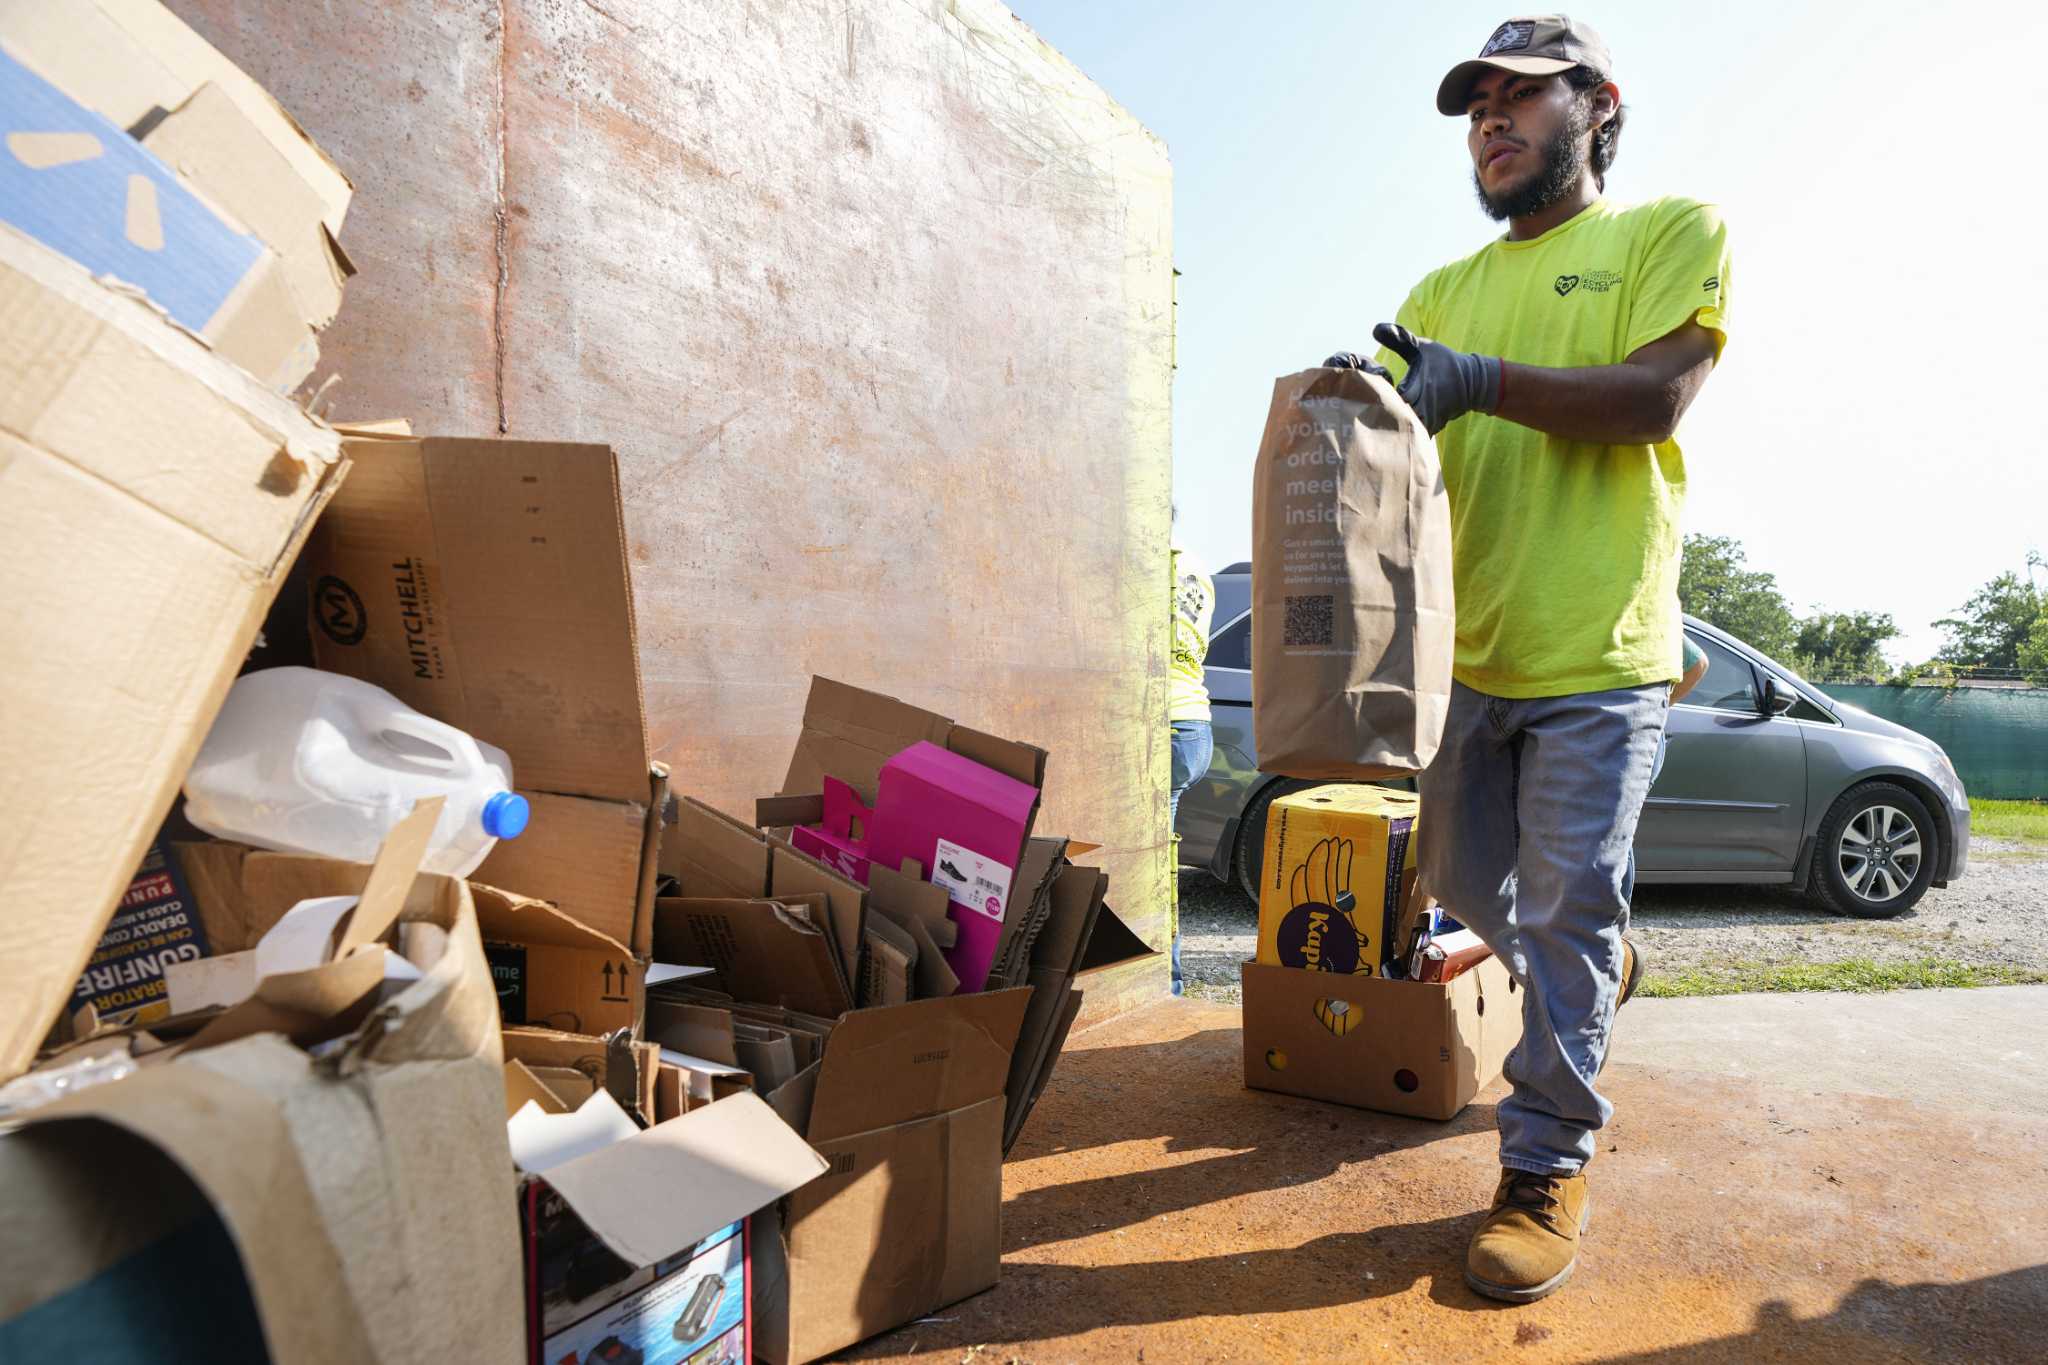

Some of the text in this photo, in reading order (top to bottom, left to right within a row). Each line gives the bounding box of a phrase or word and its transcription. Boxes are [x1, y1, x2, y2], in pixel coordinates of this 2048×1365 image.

[391, 556, 433, 680] MITCHELL
[136, 901, 182, 920] CLASS A
[133, 913, 188, 938] DEADLY
[166, 927, 193, 943] CAN
[150, 934, 166, 946] BE
[76, 943, 200, 997] GUNFIRE
